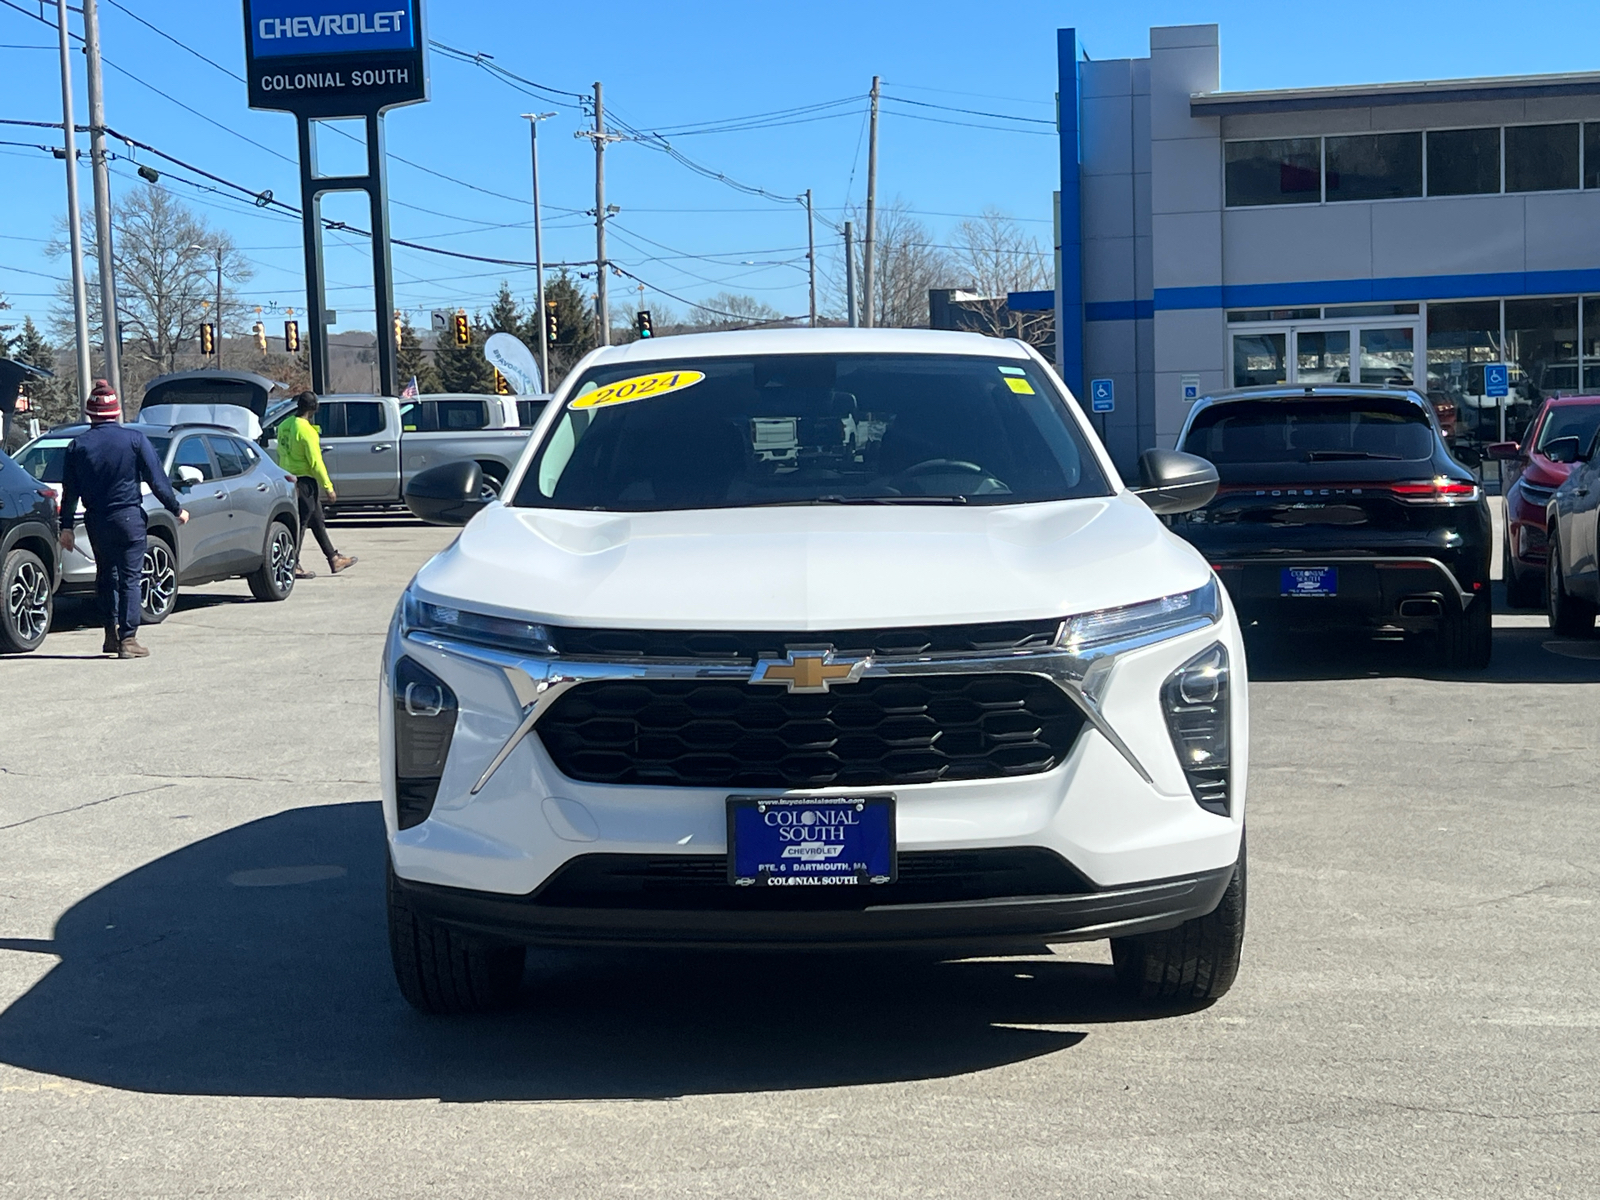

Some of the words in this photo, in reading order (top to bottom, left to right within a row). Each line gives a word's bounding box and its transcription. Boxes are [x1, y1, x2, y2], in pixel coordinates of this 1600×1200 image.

[259, 10, 405, 40] CHEVROLET
[261, 73, 346, 90] COLONIAL
[351, 69, 409, 86] SOUTH
[593, 374, 681, 404] 2024
[757, 798, 865, 806] www.buycolonialsouth.com
[764, 810, 860, 826] COLONIAL
[779, 826, 845, 842] SOUTH
[788, 847, 838, 855] CHEVROLET
[780, 863, 787, 871] 6
[793, 862, 852, 871] DARTMOUTH,
[767, 876, 821, 886] COLONIAL
[821, 876, 858, 885] SOUTH
